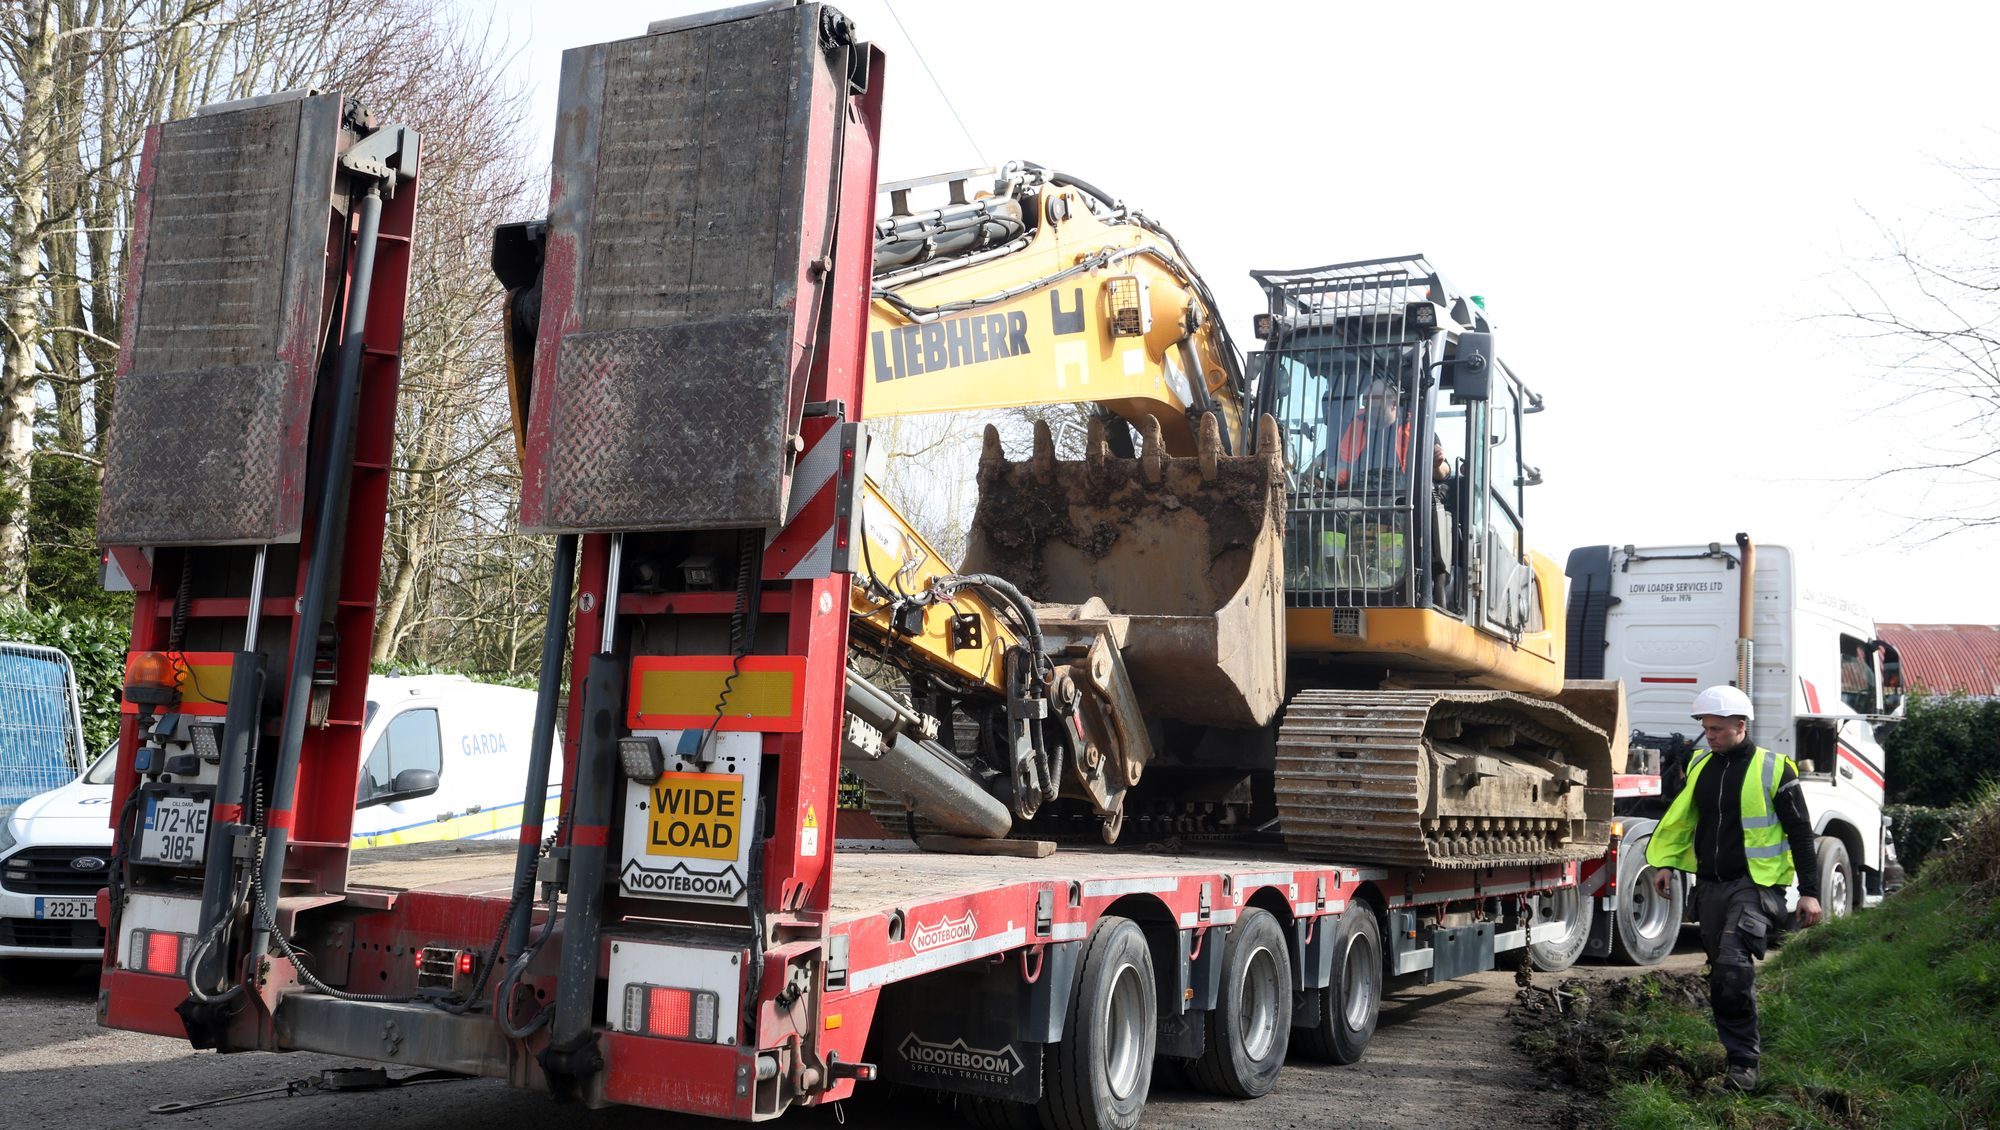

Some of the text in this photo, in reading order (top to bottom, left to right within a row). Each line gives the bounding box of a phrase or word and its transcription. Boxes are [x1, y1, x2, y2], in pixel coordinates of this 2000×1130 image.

[871, 310, 1031, 383] LIEBHERR
[1630, 582, 1723, 593] LOW LOADER SERVICES LTD
[1661, 594, 1692, 602] Since 1976
[1636, 640, 1706, 651] VOLVO
[462, 733, 507, 756] GARDA
[655, 788, 735, 817] WIDE
[154, 807, 207, 834] 172-KE
[652, 820, 733, 849] LOAD
[160, 835, 195, 860] 3185
[76, 859, 96, 868] Ford
[630, 872, 732, 895] NOOTEBOOM
[50, 902, 97, 918] 232-D-
[917, 923, 971, 951] NOOTEBOOM
[910, 1046, 1010, 1073] NOOTEBOOM
[911, 1063, 1009, 1084] SPECIAL TRAILERS
